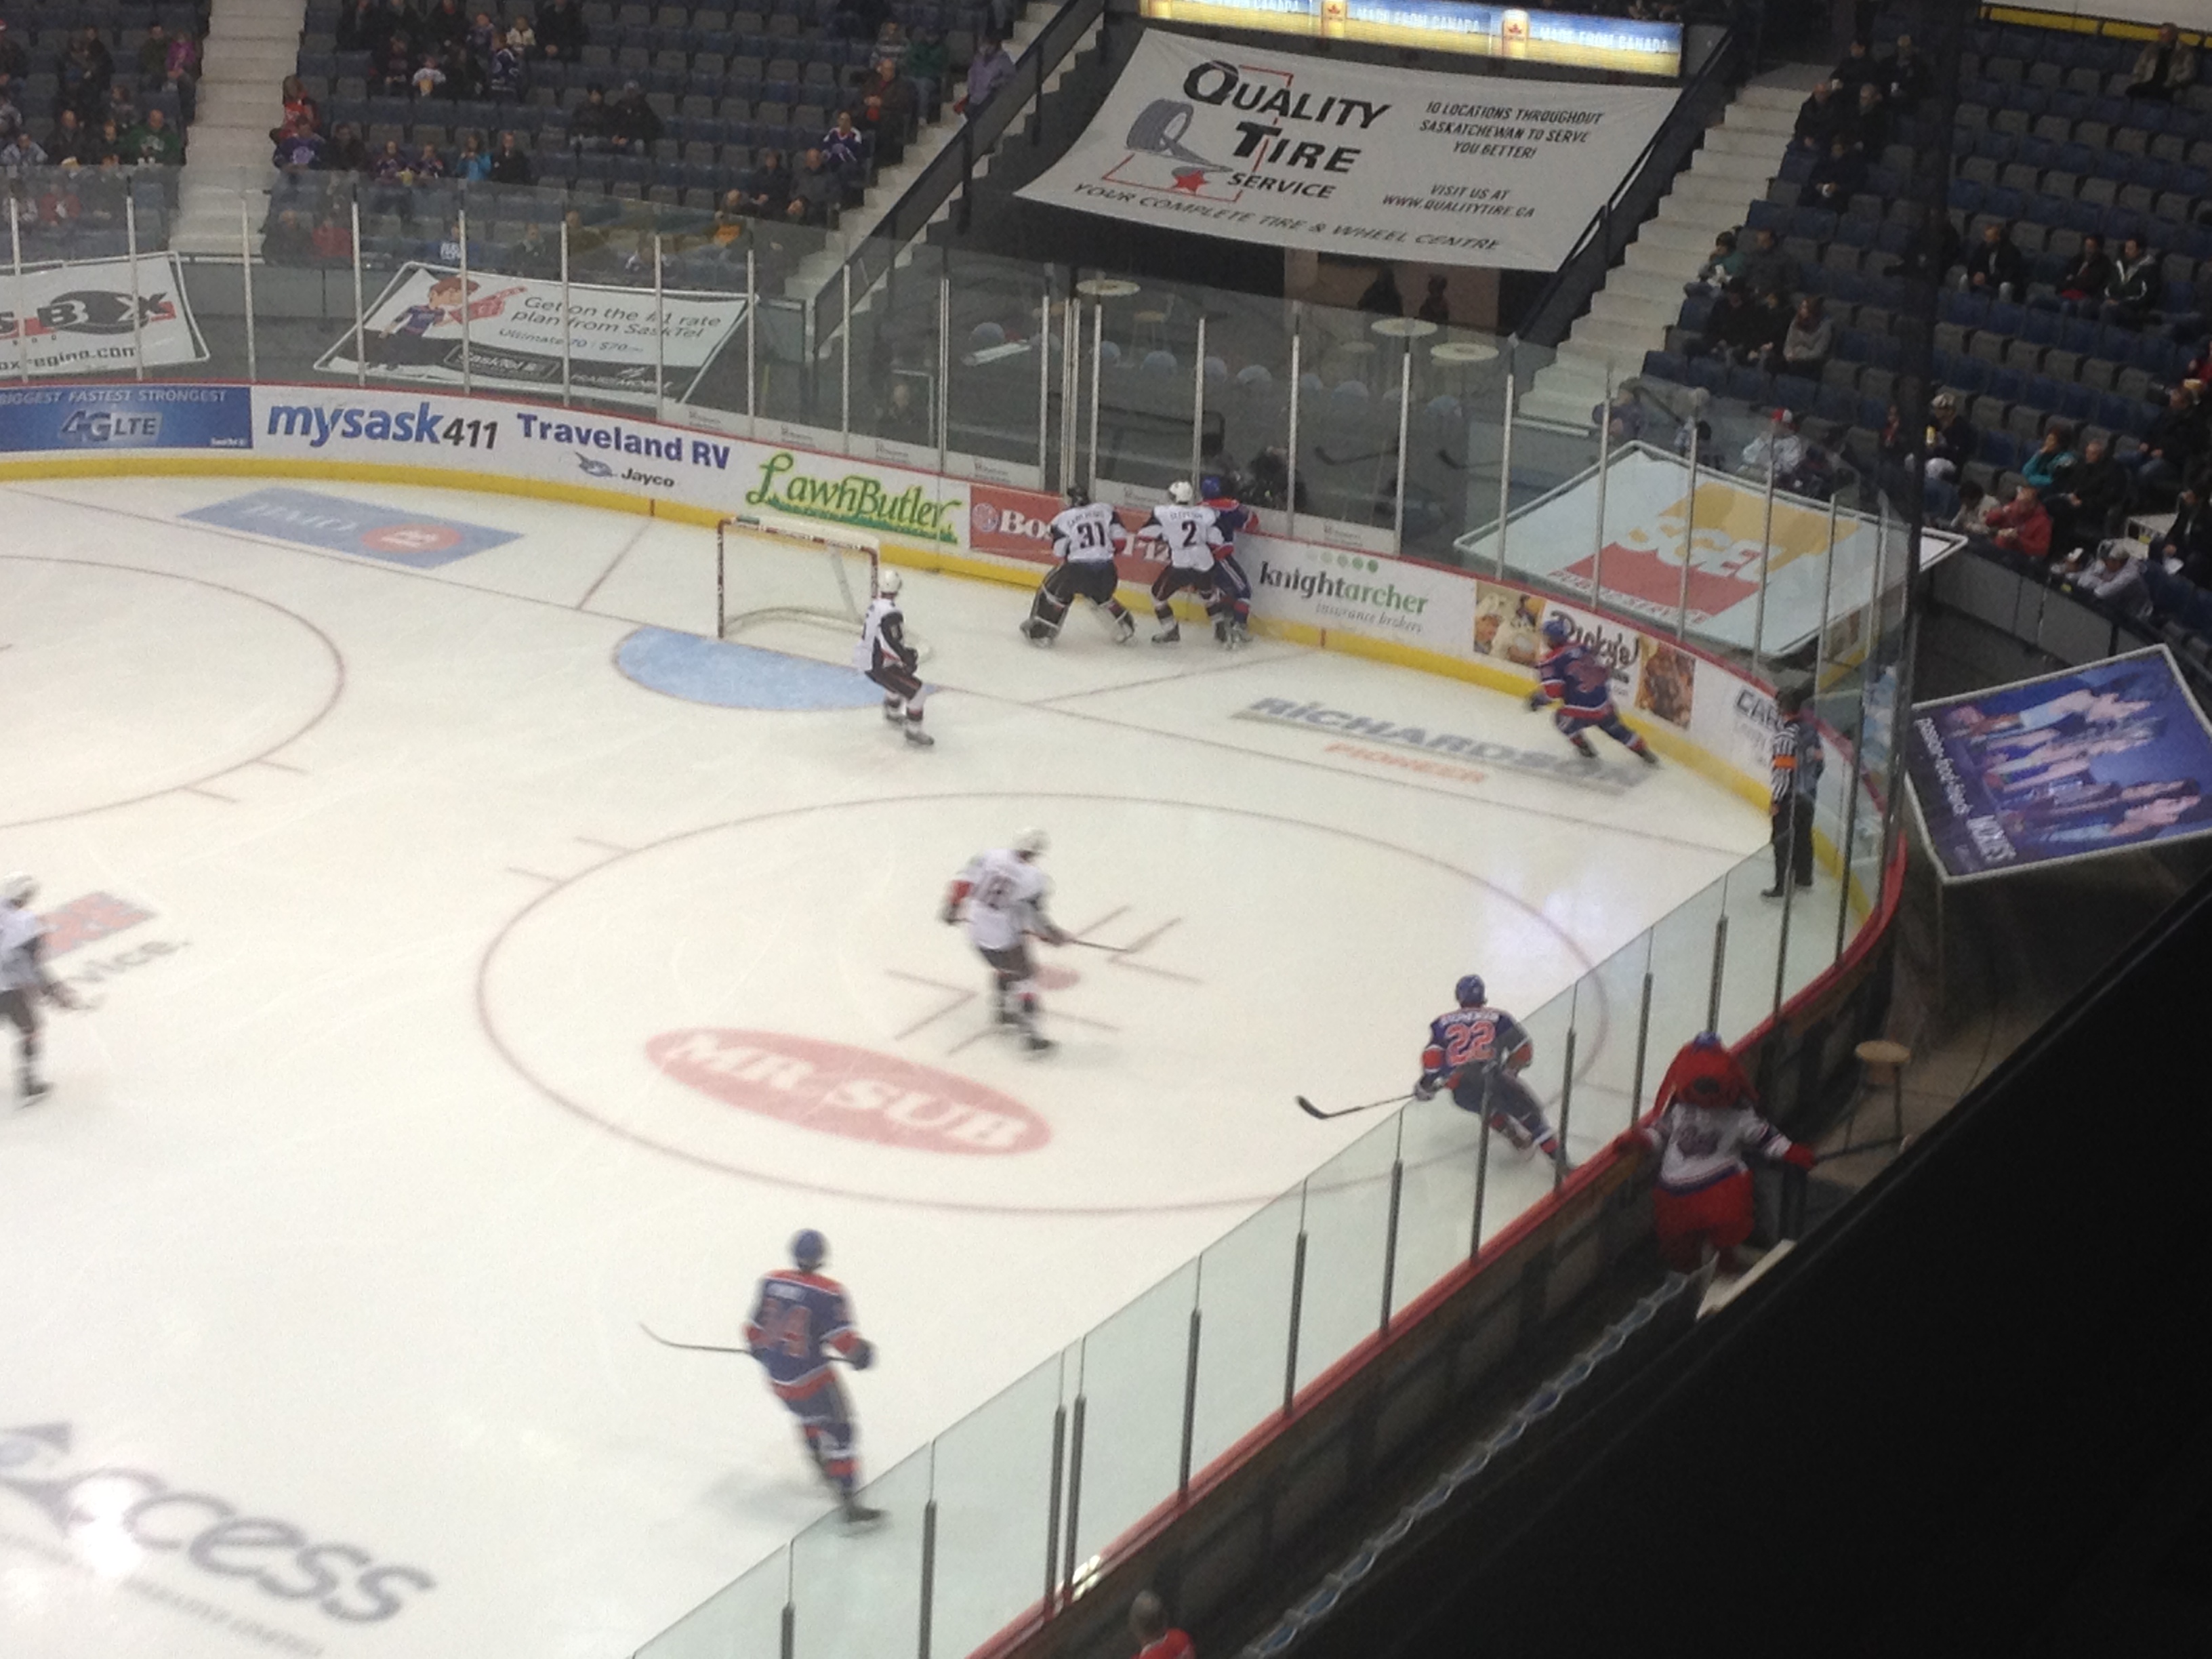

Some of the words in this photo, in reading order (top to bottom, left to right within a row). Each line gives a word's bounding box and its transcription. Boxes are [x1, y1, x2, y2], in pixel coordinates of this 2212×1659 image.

[1618, 35, 1669, 52] CANADA
[1183, 59, 1391, 129] QUALITY
[1425, 101, 1441, 115] 10
[1442, 102, 1513, 121] LOCATIONS
[1514, 108, 1605, 125] THROUGHOUT
[1419, 119, 1524, 140] SASKATCHEWAN
[1526, 128, 1544, 140] TO
[1544, 129, 1591, 144] SERVE
[1233, 121, 1361, 174] TIRE
[1452, 141, 1479, 155] YOU
[1480, 144, 1538, 159] BETTER!
[1227, 172, 1337, 200] SERVICE
[1430, 184, 1468, 197] VISIT
[1469, 186, 1489, 199] US
[1490, 189, 1511, 201] AT
[1073, 182, 1136, 203] YOUR
[1139, 196, 1256, 222] COMPLETE
[1258, 214, 1309, 232] TIRE
[1309, 222, 1328, 233] &
[1332, 224, 1410, 244] WHEEL
[1414, 233, 1501, 251] CENTRE
[1382, 194, 1536, 218] WWW.QUALITYTIRE.CA
[510, 310, 560, 327] plan
[567, 316, 620, 333] from
[623, 322, 705, 339] SaskTel
[524, 296, 563, 312] Get
[569, 305, 597, 317] on
[603, 307, 639, 321] the
[678, 316, 722, 327] rate
[67, 389, 131, 404] FASTEST
[137, 389, 228, 403] STRONGEST
[59, 409, 112, 441] 4G
[114, 416, 157, 436] LTE
[266, 402, 499, 449] mysask411
[517, 412, 684, 462] Traveland
[691, 442, 732, 470] RV
[620, 468, 676, 489] Jayco
[745, 451, 962, 529] LawnButler
[1077, 521, 1106, 550] 31
[1181, 519, 1197, 548] 2
[1258, 560, 1429, 615] knightarcher
[1315, 602, 1376, 623] insurance
[1378, 612, 1424, 634] brokers
[1443, 1019, 1489, 1061] 22
